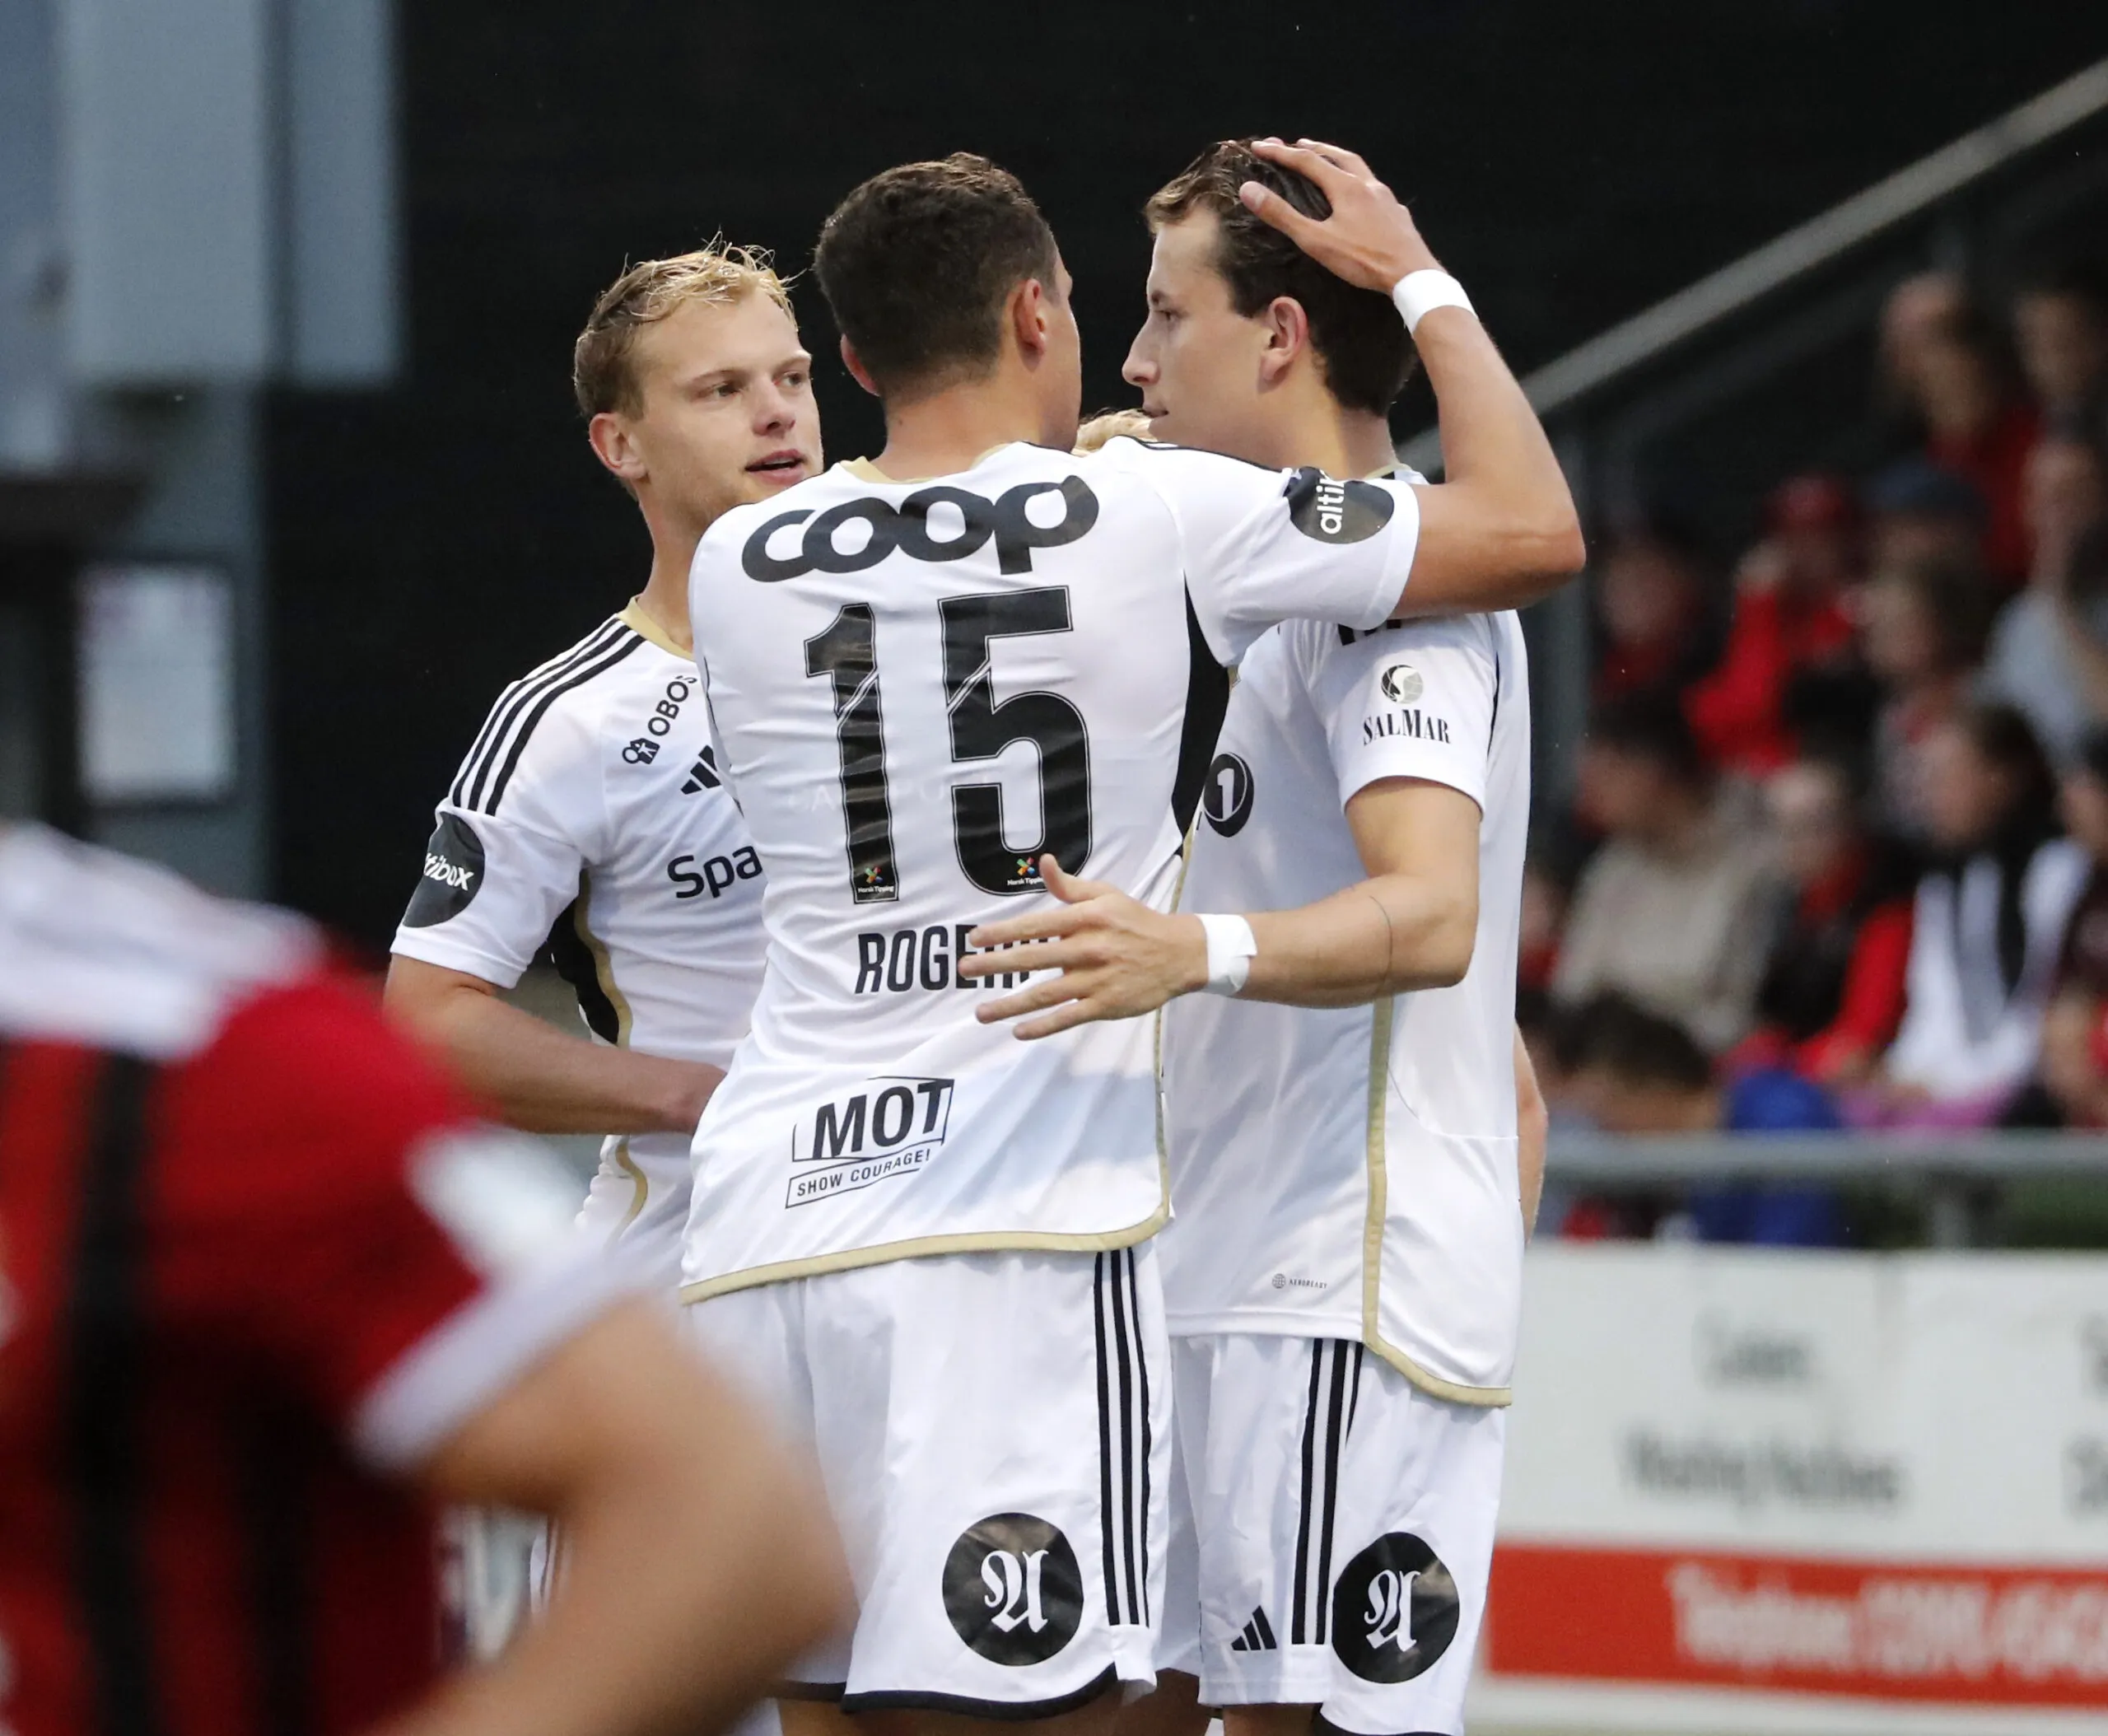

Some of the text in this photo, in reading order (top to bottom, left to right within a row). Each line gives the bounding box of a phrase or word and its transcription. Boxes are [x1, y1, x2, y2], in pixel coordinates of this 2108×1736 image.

[741, 475, 1099, 582] coop
[804, 586, 1093, 904] 15
[667, 846, 763, 899] Spa
[812, 1079, 954, 1160] MOT
[797, 1149, 930, 1197] SHOW COURAGE!
